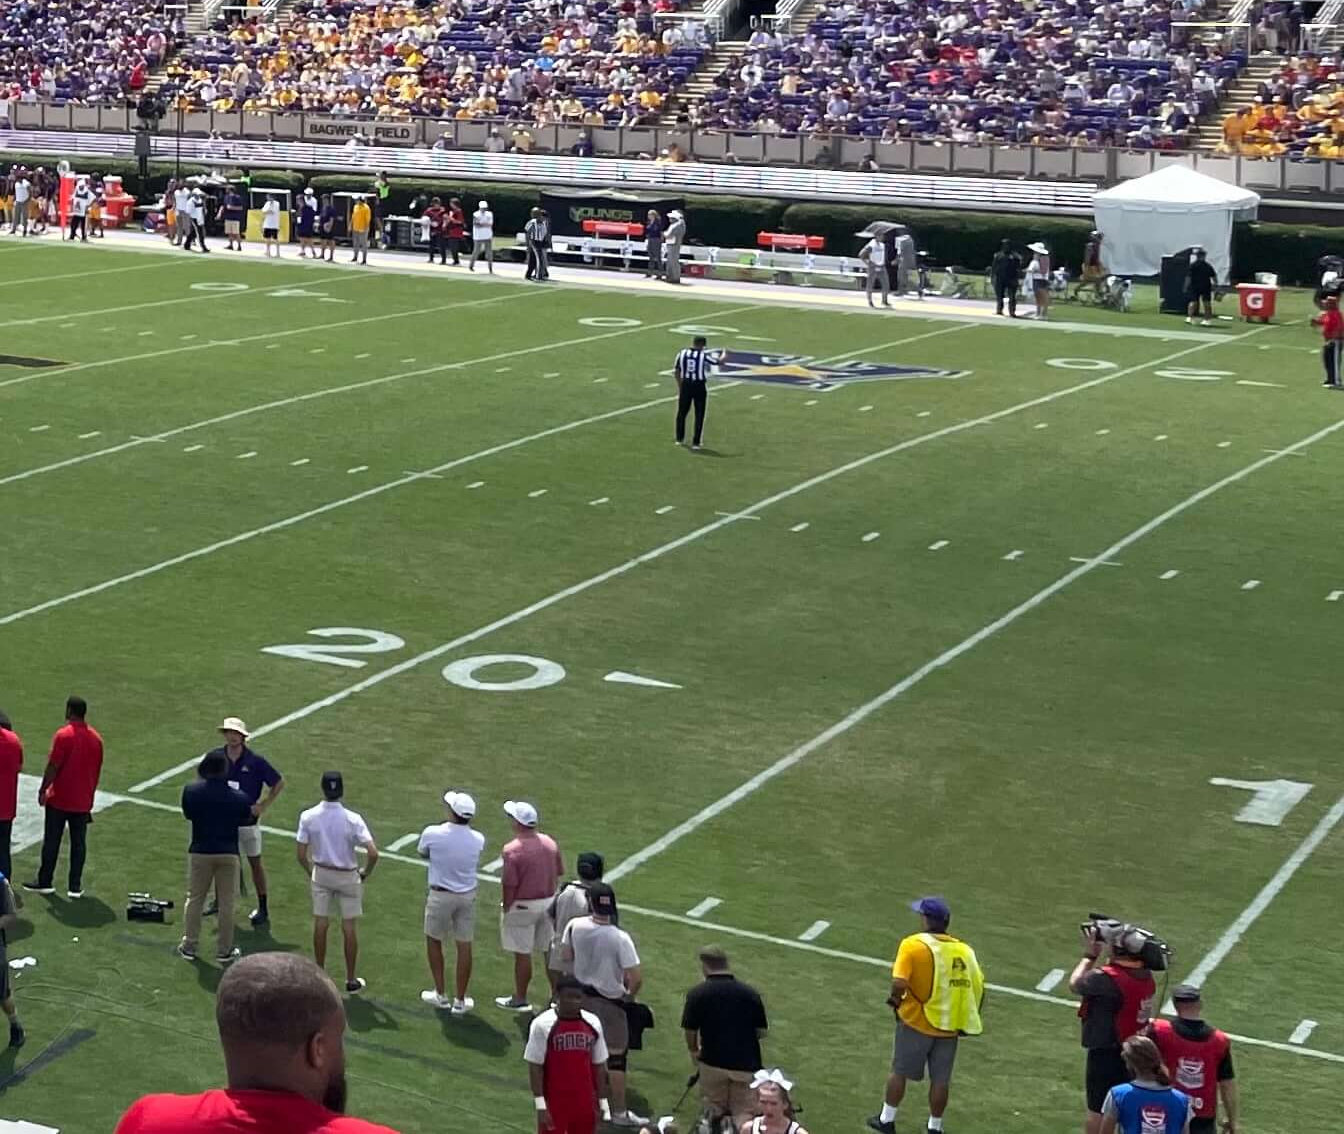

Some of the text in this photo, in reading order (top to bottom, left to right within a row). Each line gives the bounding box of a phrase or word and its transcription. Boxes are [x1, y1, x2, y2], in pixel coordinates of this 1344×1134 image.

[309, 124, 410, 139] BAGWELL FIELD
[260, 627, 565, 691] 20
